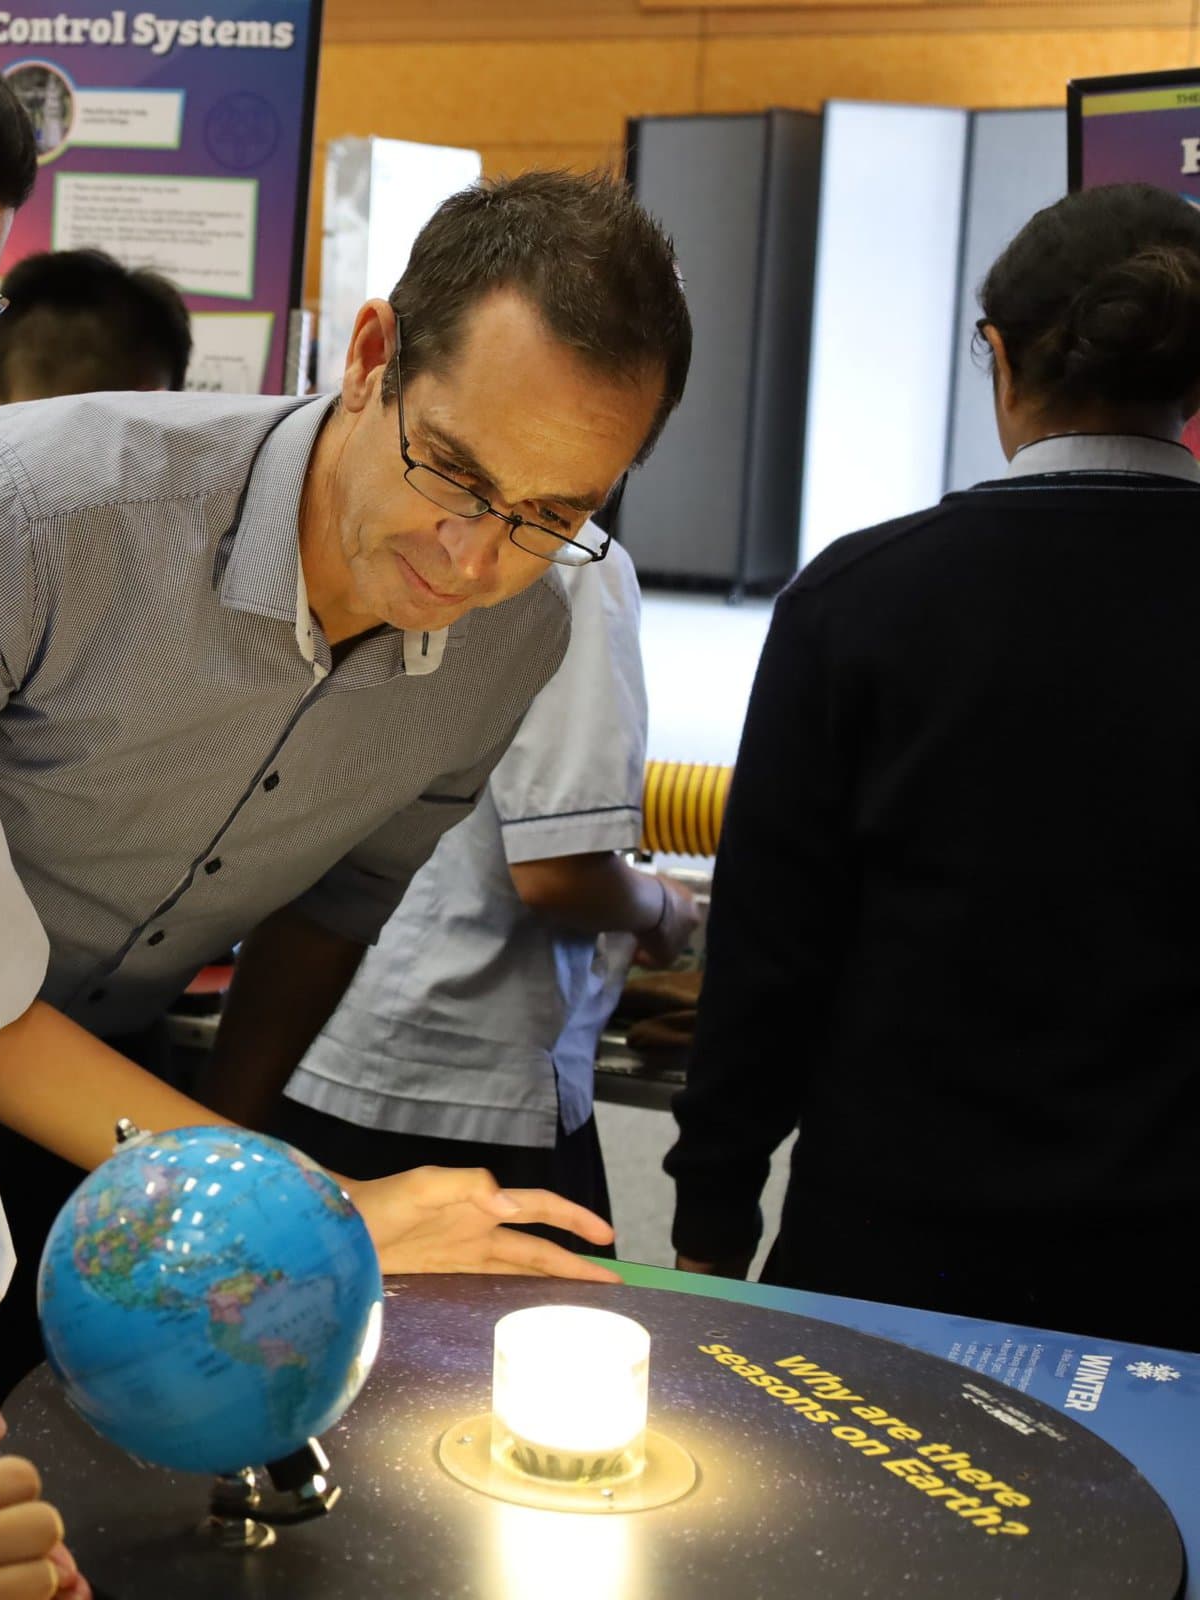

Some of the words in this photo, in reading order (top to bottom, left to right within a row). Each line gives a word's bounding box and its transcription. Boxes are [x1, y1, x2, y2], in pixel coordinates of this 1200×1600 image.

[132, 13, 294, 54] Systems
[774, 1355, 865, 1402] Why
[851, 1405, 923, 1442] are
[916, 1443, 1032, 1508] there
[1064, 1354, 1113, 1412] WINTER
[698, 1343, 840, 1424] seasons
[831, 1425, 892, 1457] on
[882, 1457, 1030, 1536] Earth?
